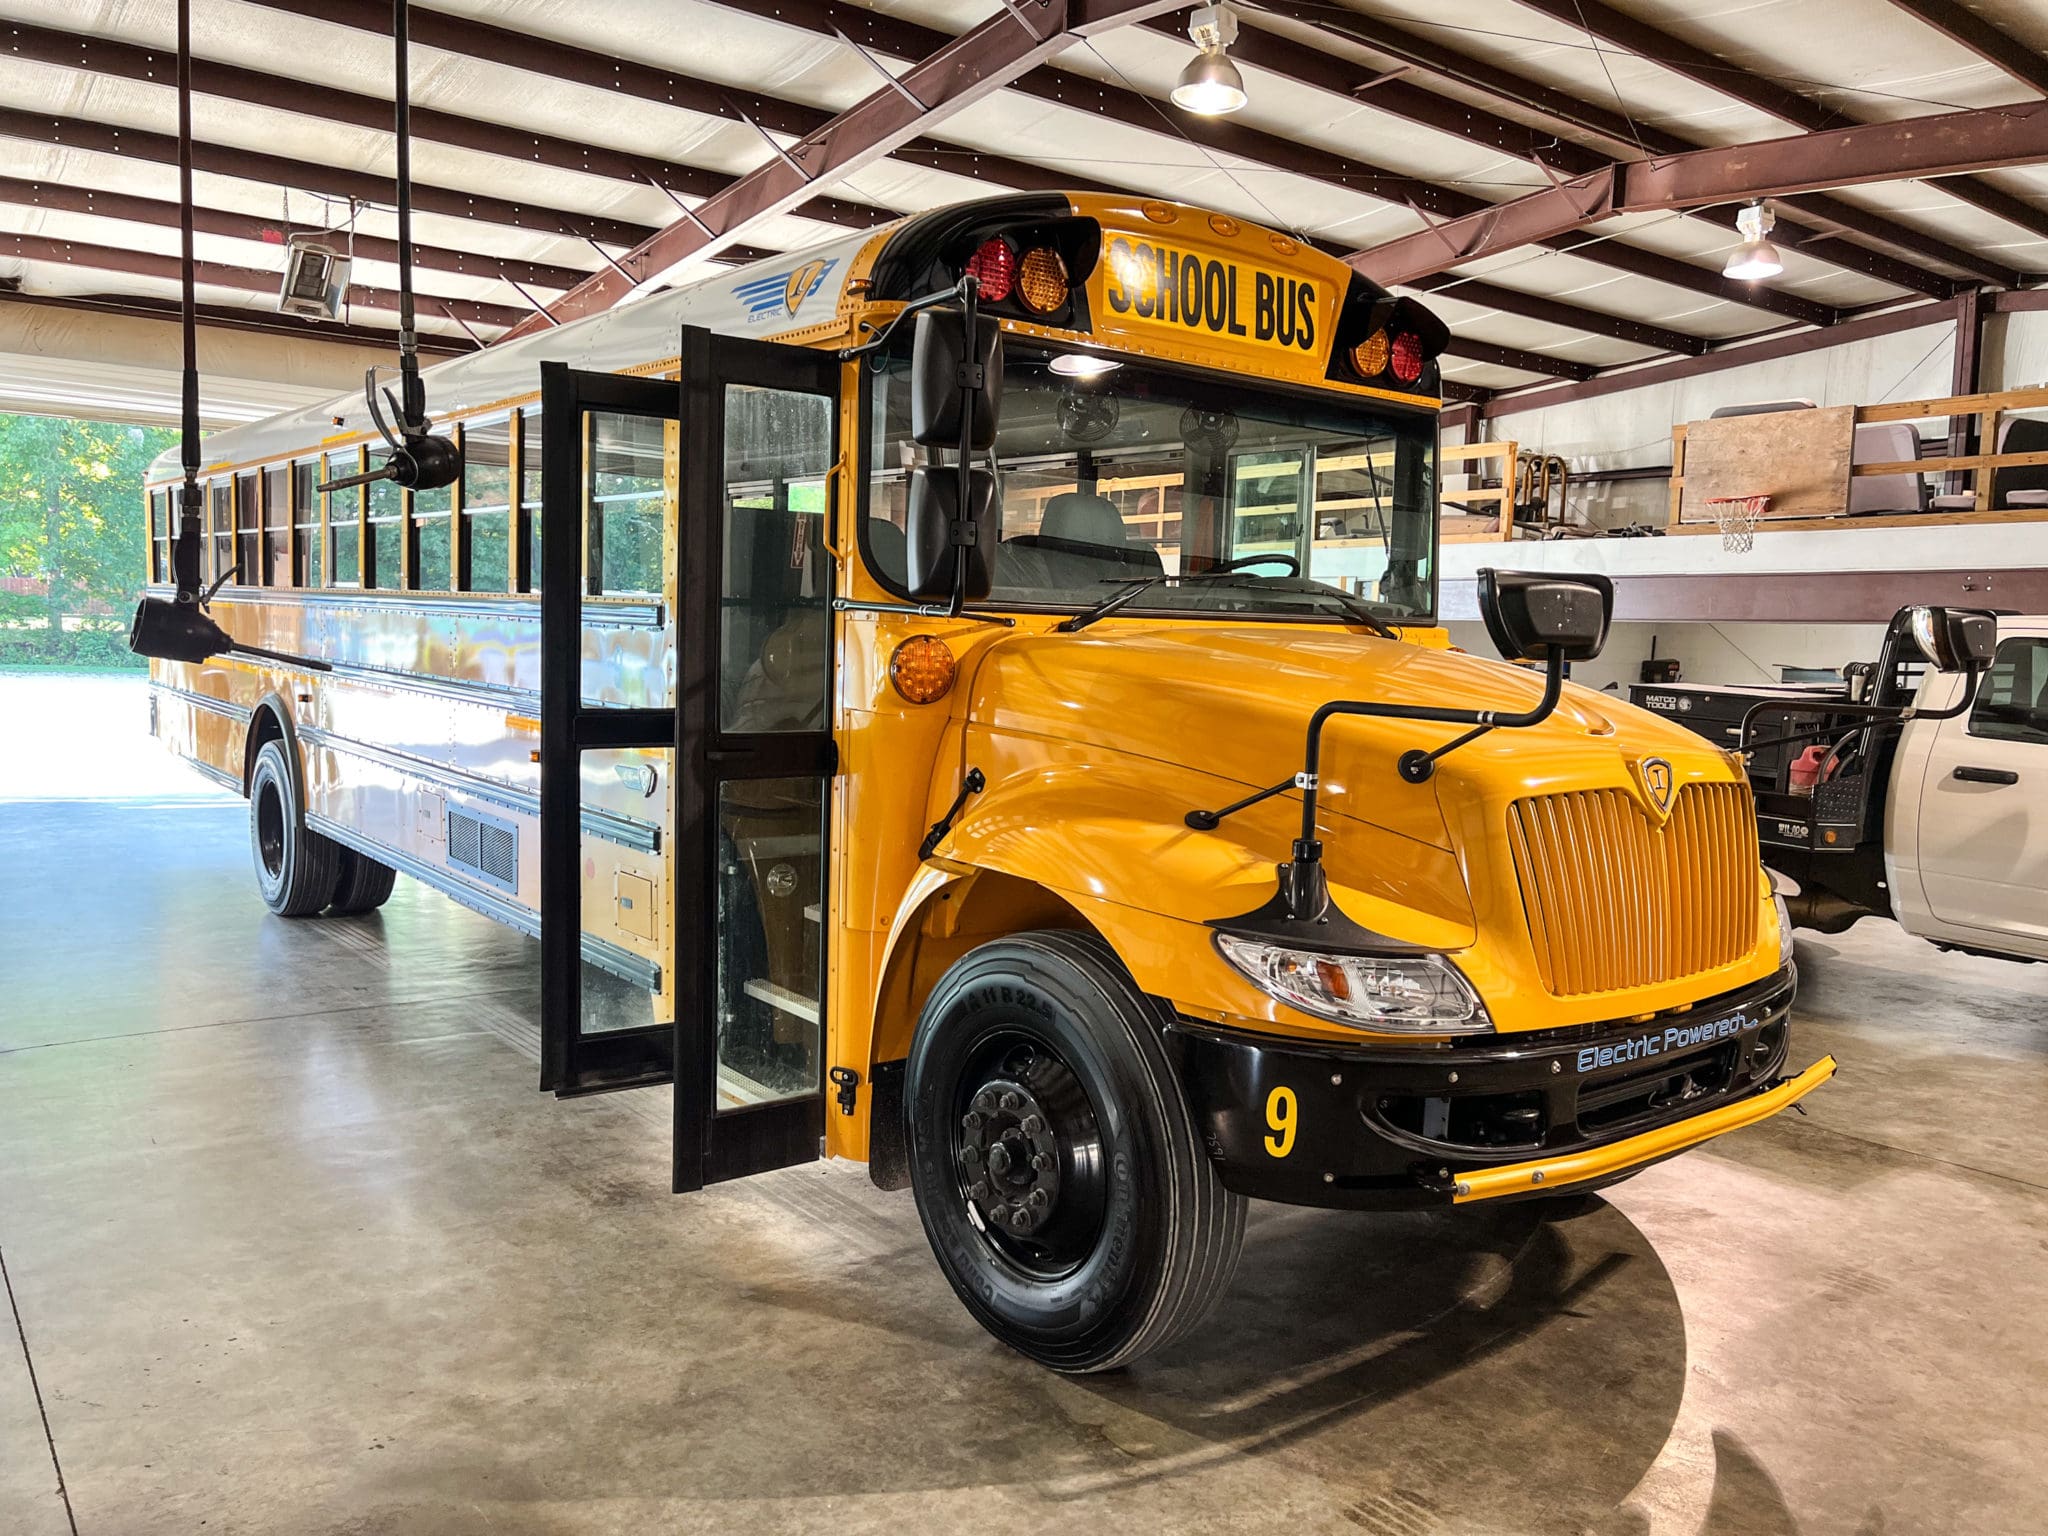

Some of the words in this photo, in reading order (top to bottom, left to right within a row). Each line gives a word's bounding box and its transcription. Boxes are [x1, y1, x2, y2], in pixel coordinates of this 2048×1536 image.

[1108, 237, 1246, 337] SCHOOL
[1255, 271, 1315, 350] BUS
[747, 308, 783, 324] ELECTRIC
[1645, 695, 1677, 704] MATCO
[1645, 701, 1676, 710] TOOLS
[1576, 1034, 1661, 1073] Electric
[1663, 1012, 1744, 1051] Powered
[1264, 1086, 1298, 1158] 9
